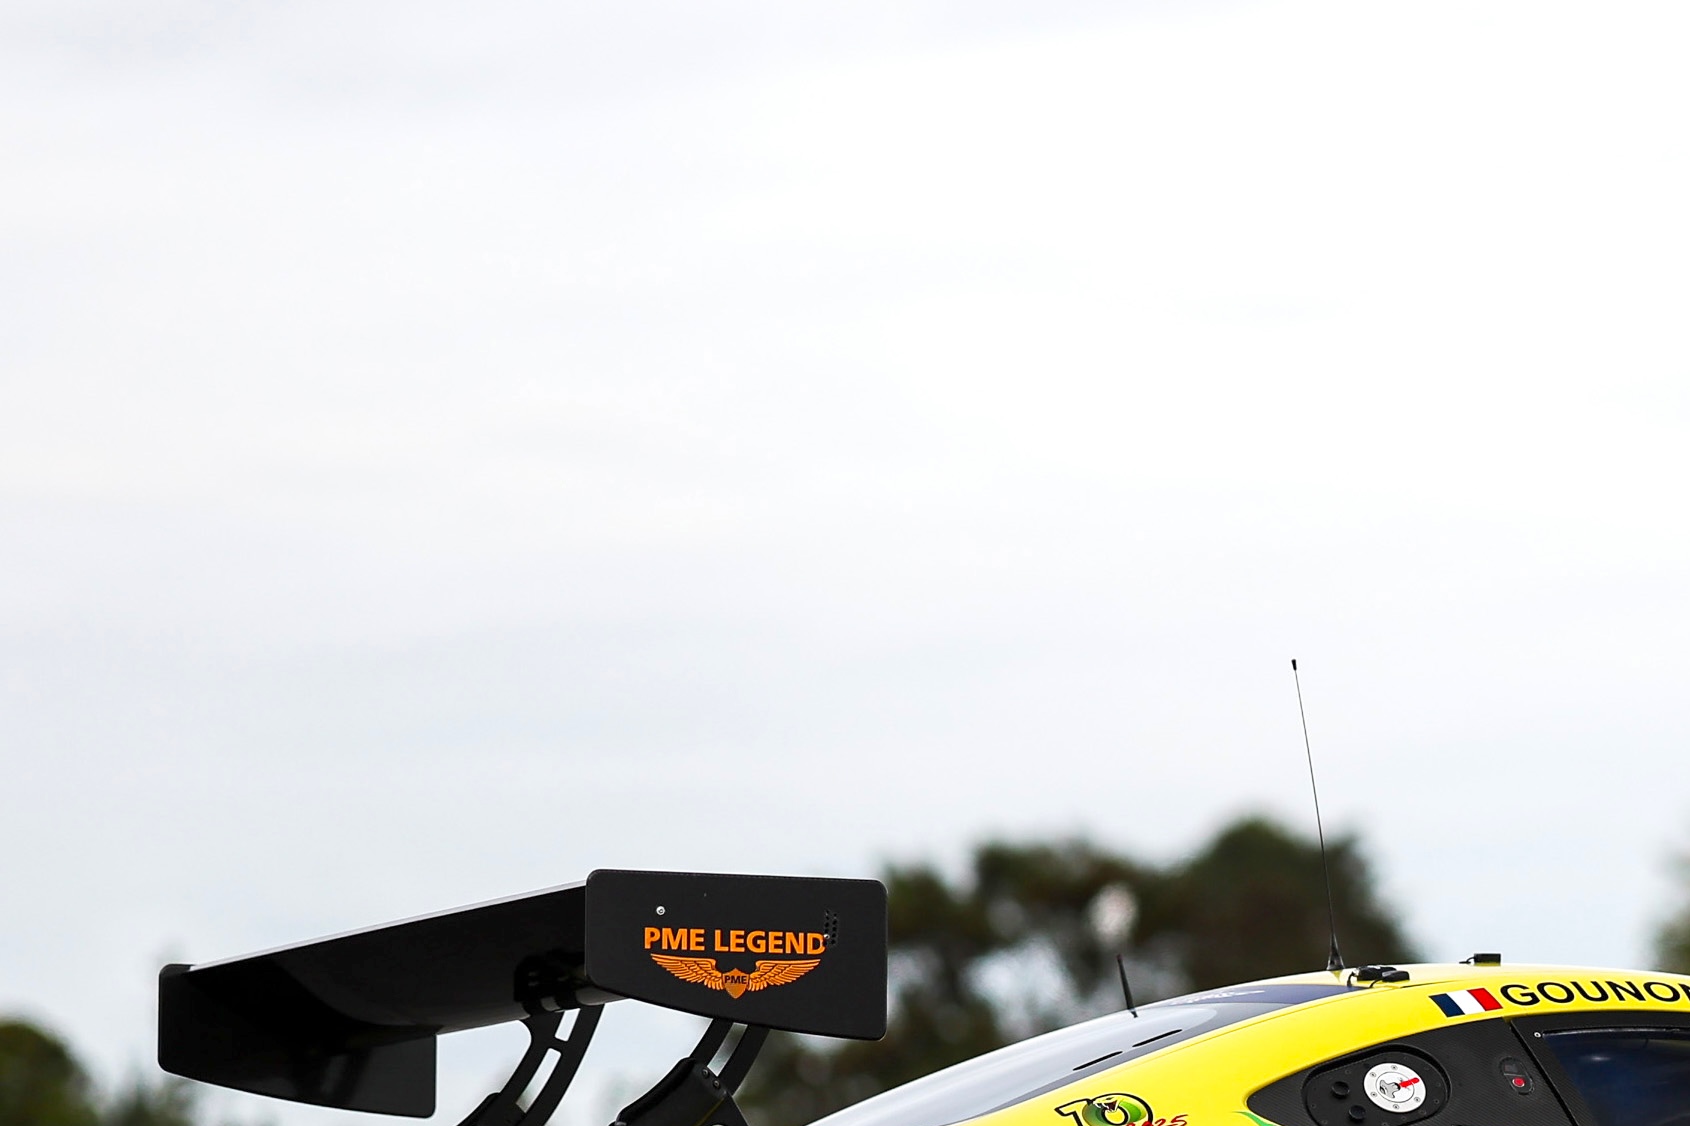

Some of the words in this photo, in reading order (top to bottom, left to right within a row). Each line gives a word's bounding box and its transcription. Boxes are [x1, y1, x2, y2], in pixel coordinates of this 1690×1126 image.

[644, 926, 705, 951] PME
[714, 929, 826, 955] LEGEND
[724, 975, 748, 985] PME
